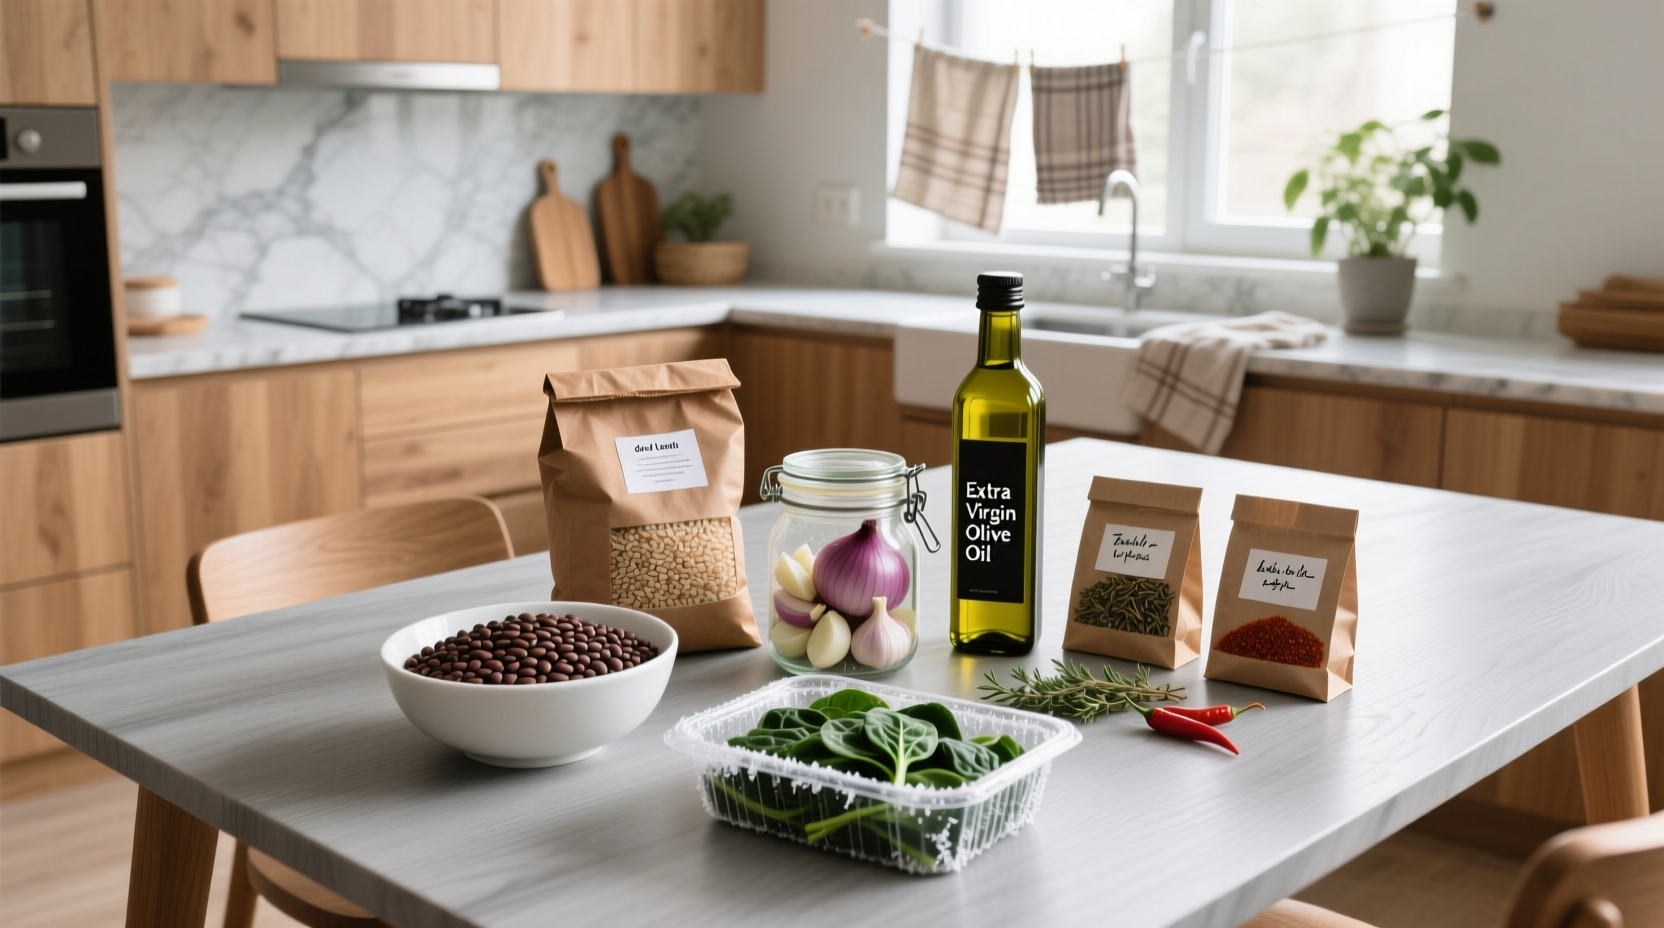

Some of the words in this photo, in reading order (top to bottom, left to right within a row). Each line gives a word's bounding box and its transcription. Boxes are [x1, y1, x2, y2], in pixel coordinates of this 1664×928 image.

[966, 481, 1011, 500] Extra
[966, 502, 1016, 525] Virgin
[965, 524, 1011, 542] Olive
[965, 544, 991, 562] Oil
